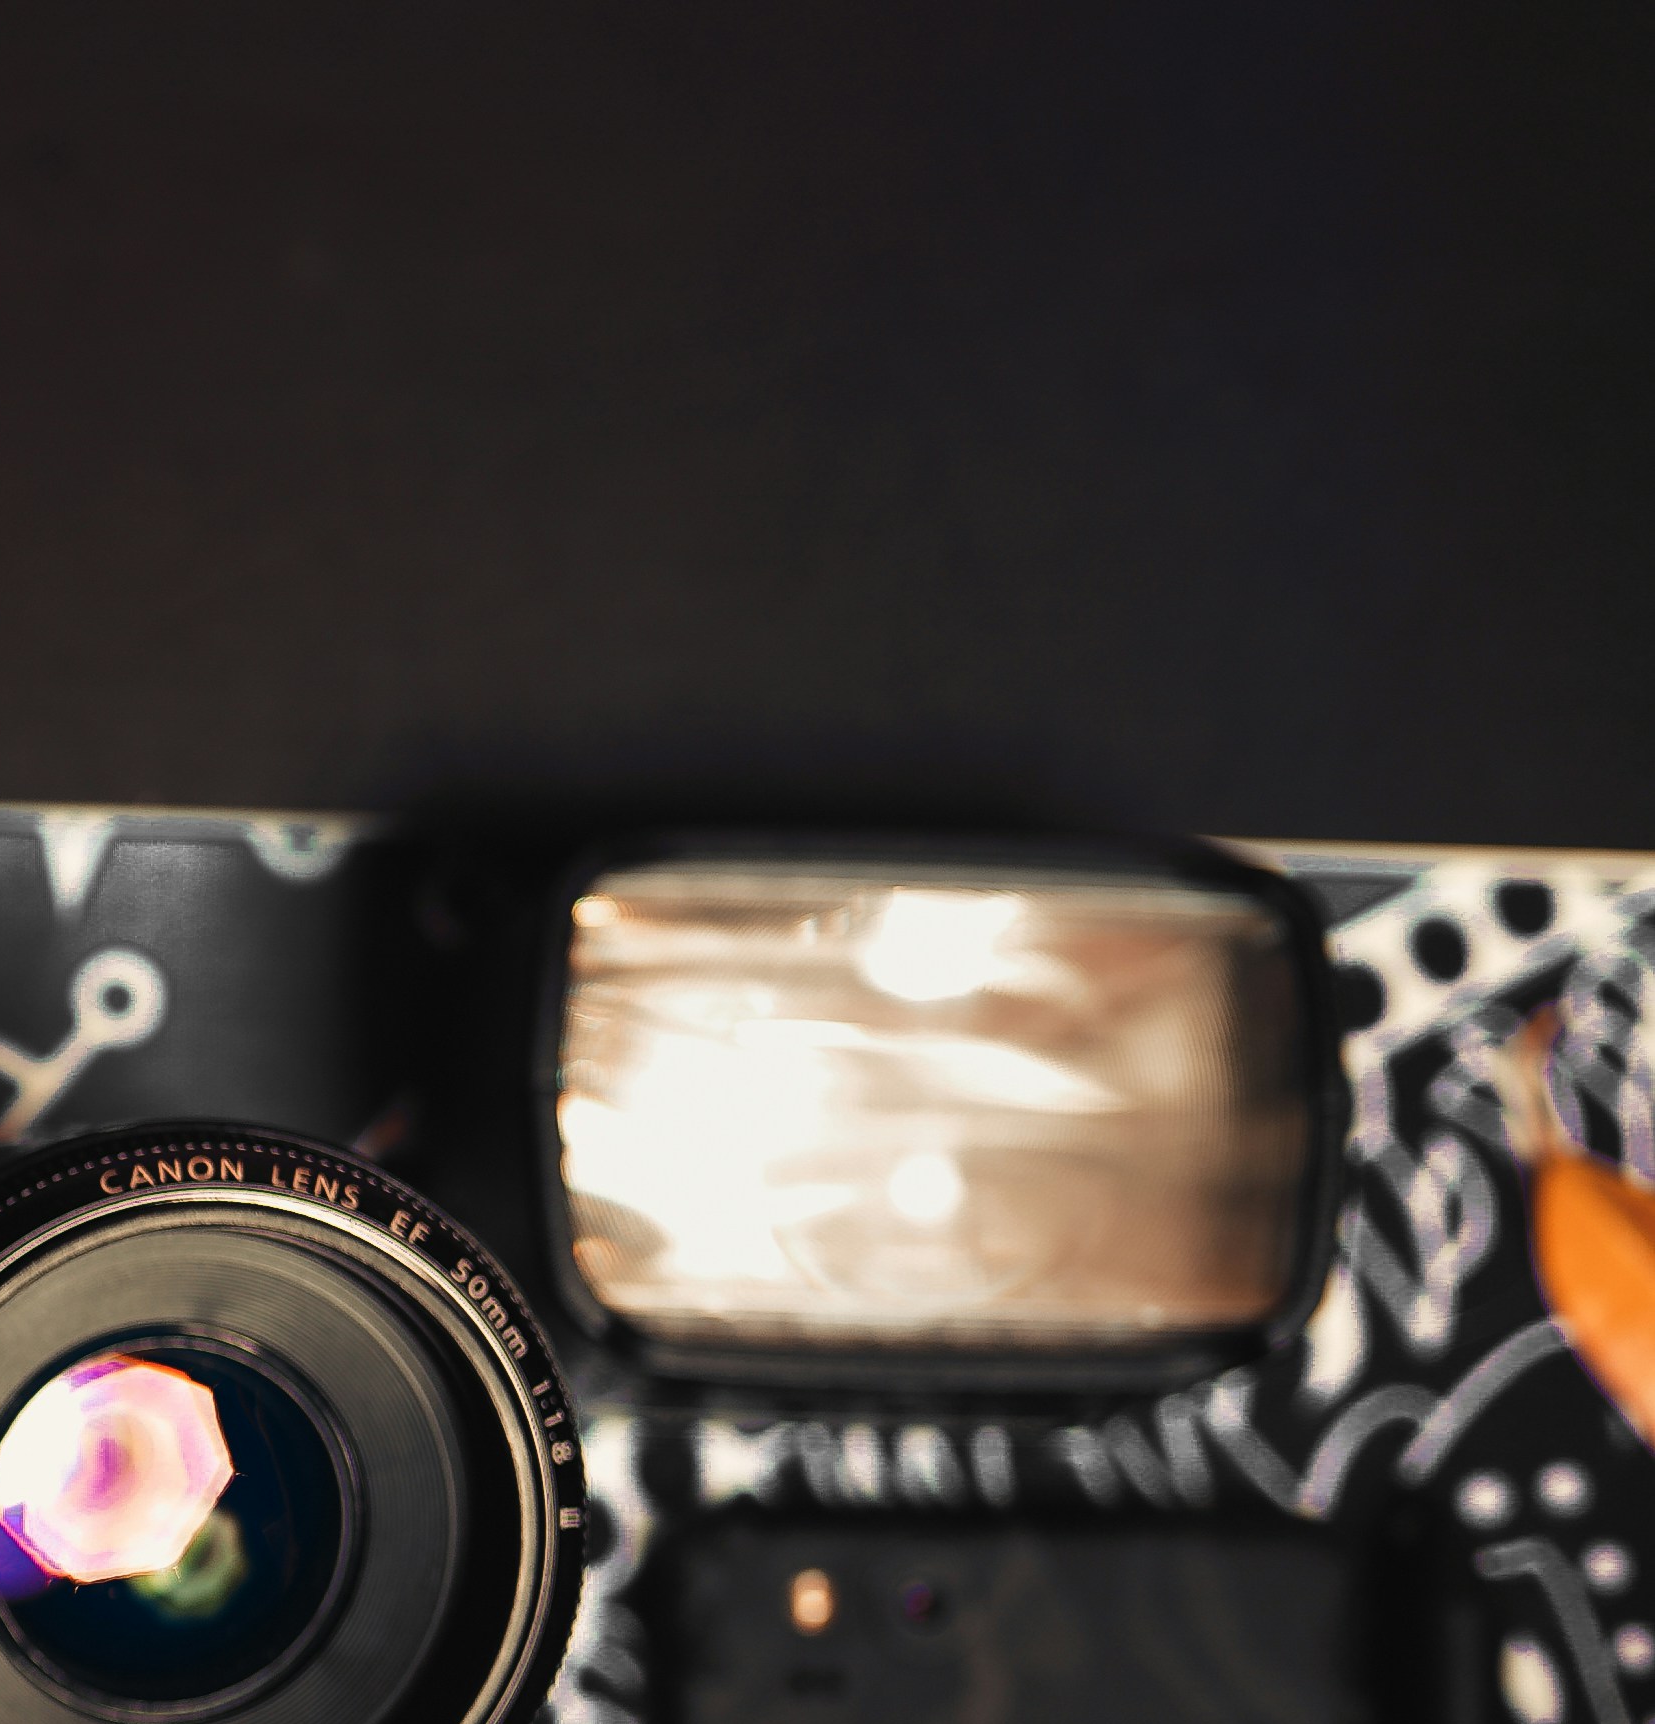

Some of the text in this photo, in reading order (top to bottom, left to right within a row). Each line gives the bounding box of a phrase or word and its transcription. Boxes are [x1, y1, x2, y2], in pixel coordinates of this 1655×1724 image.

[99, 1153, 245, 1196] CANON
[270, 1163, 362, 1212] LENS
[389, 1208, 432, 1246] EF
[449, 1257, 529, 1361] 50mm
[531, 1376, 577, 1466] 1:1.8
